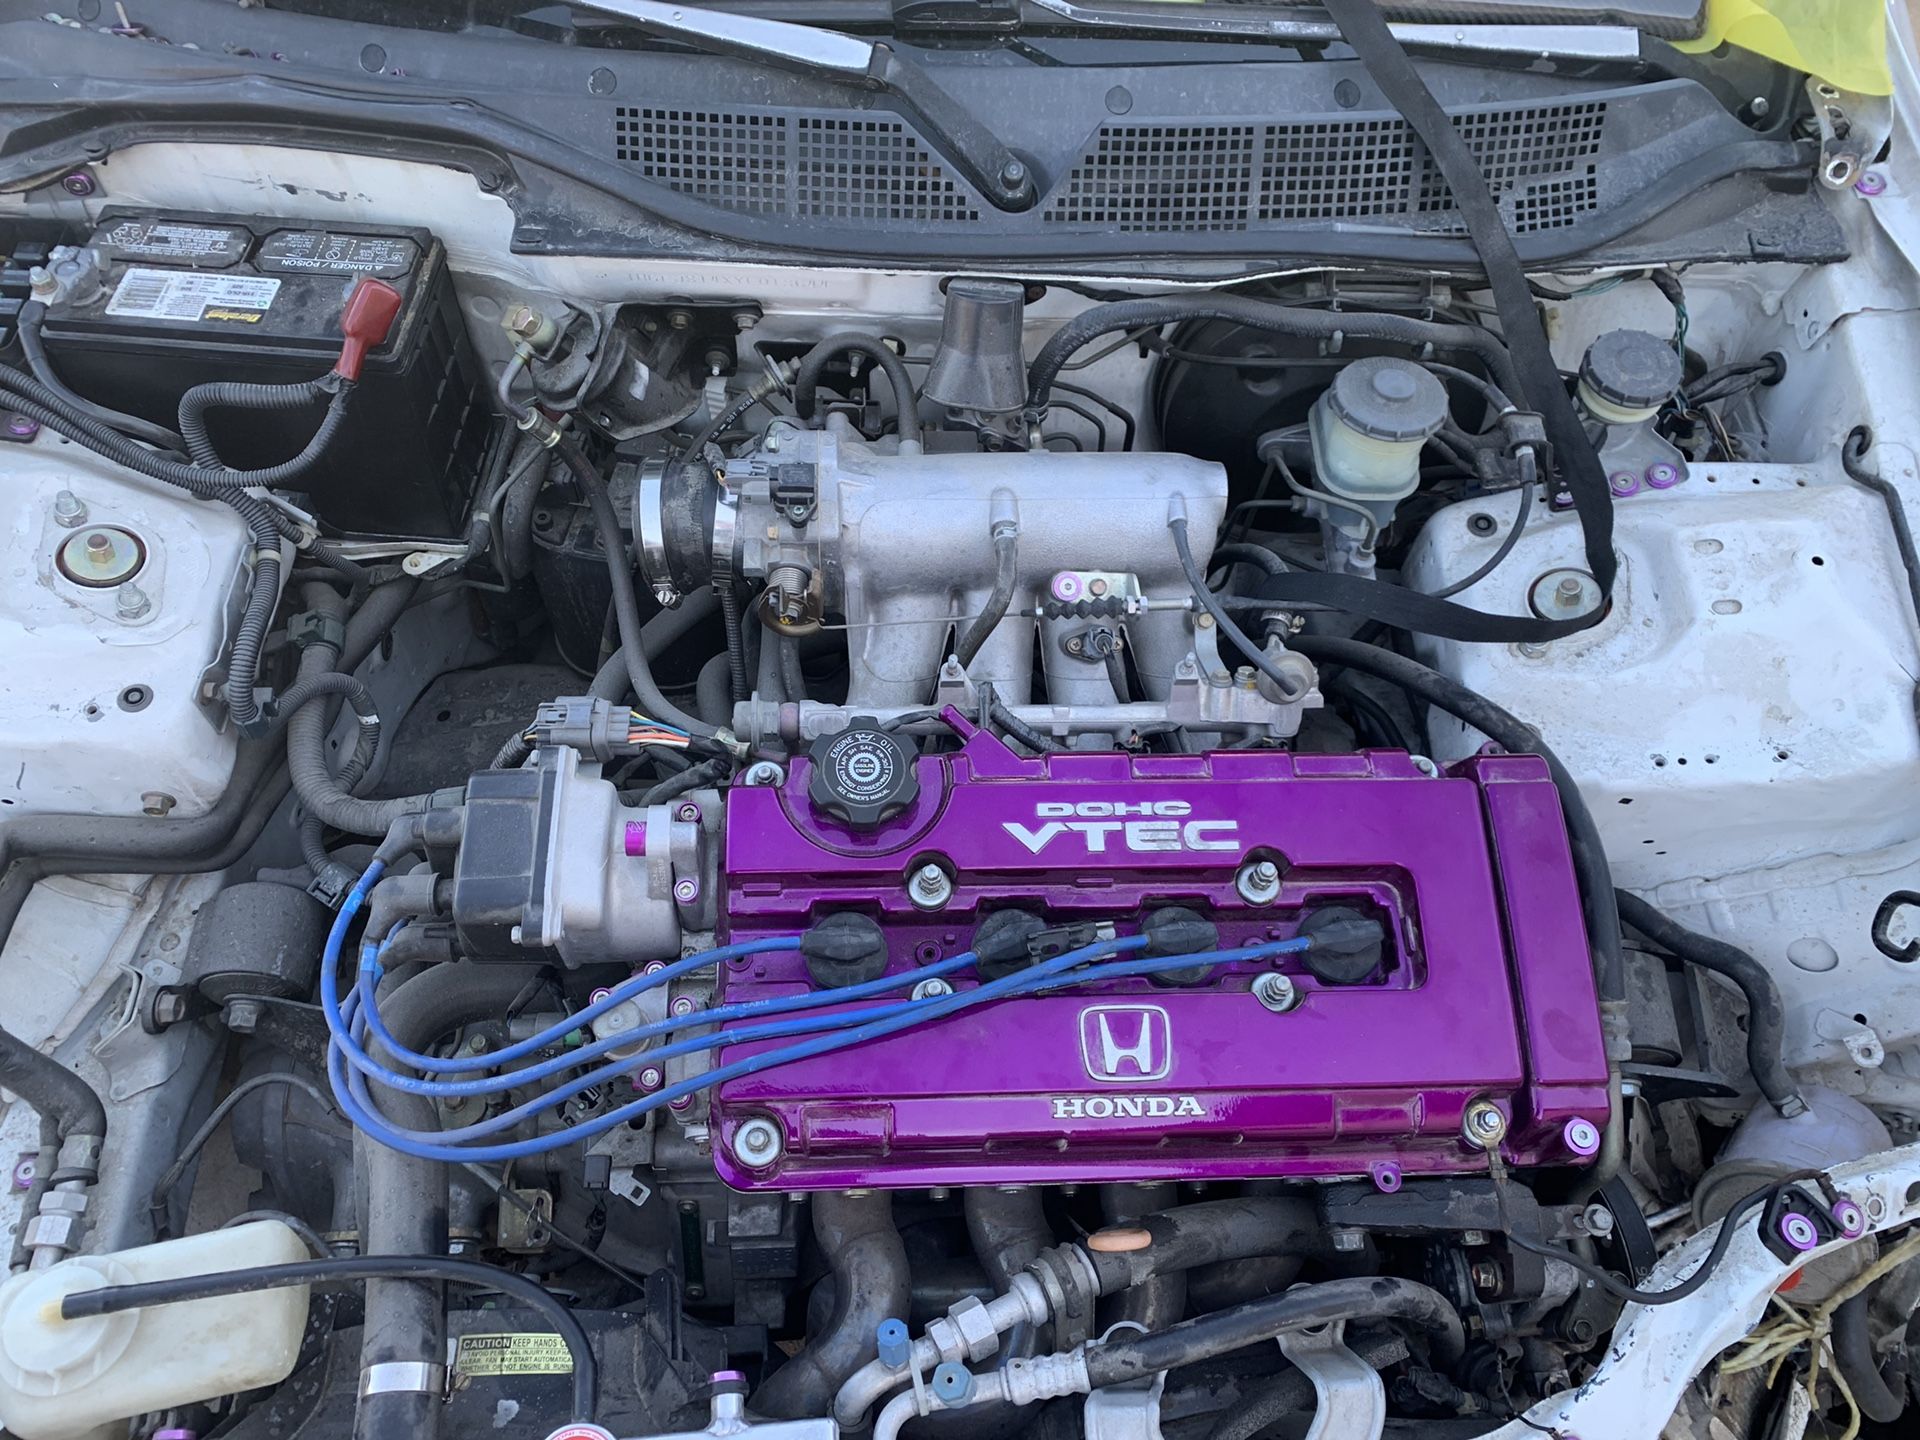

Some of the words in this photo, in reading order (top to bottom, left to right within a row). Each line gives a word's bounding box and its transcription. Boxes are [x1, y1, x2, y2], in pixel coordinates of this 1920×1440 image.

[282, 259, 320, 268] POISON
[330, 262, 373, 271] DANGER
[830, 735, 854, 758] ENGINE
[880, 739, 894, 754] OIL
[839, 770, 857, 789] ENERGY
[857, 773, 889, 791] CONSERVING
[836, 785, 847, 795] SEE
[847, 792, 869, 801] OWNER'S
[870, 789, 891, 801] MANUAL
[1036, 801, 1191, 817] DOHC
[1001, 820, 1240, 855] VTEC
[743, 1000, 769, 1009] CABLE
[1053, 1096, 1206, 1118] HONDA
[463, 1338, 510, 1349] CAUTION
[512, 1338, 531, 1348] KEEP
[533, 1338, 558, 1348] HANDS
